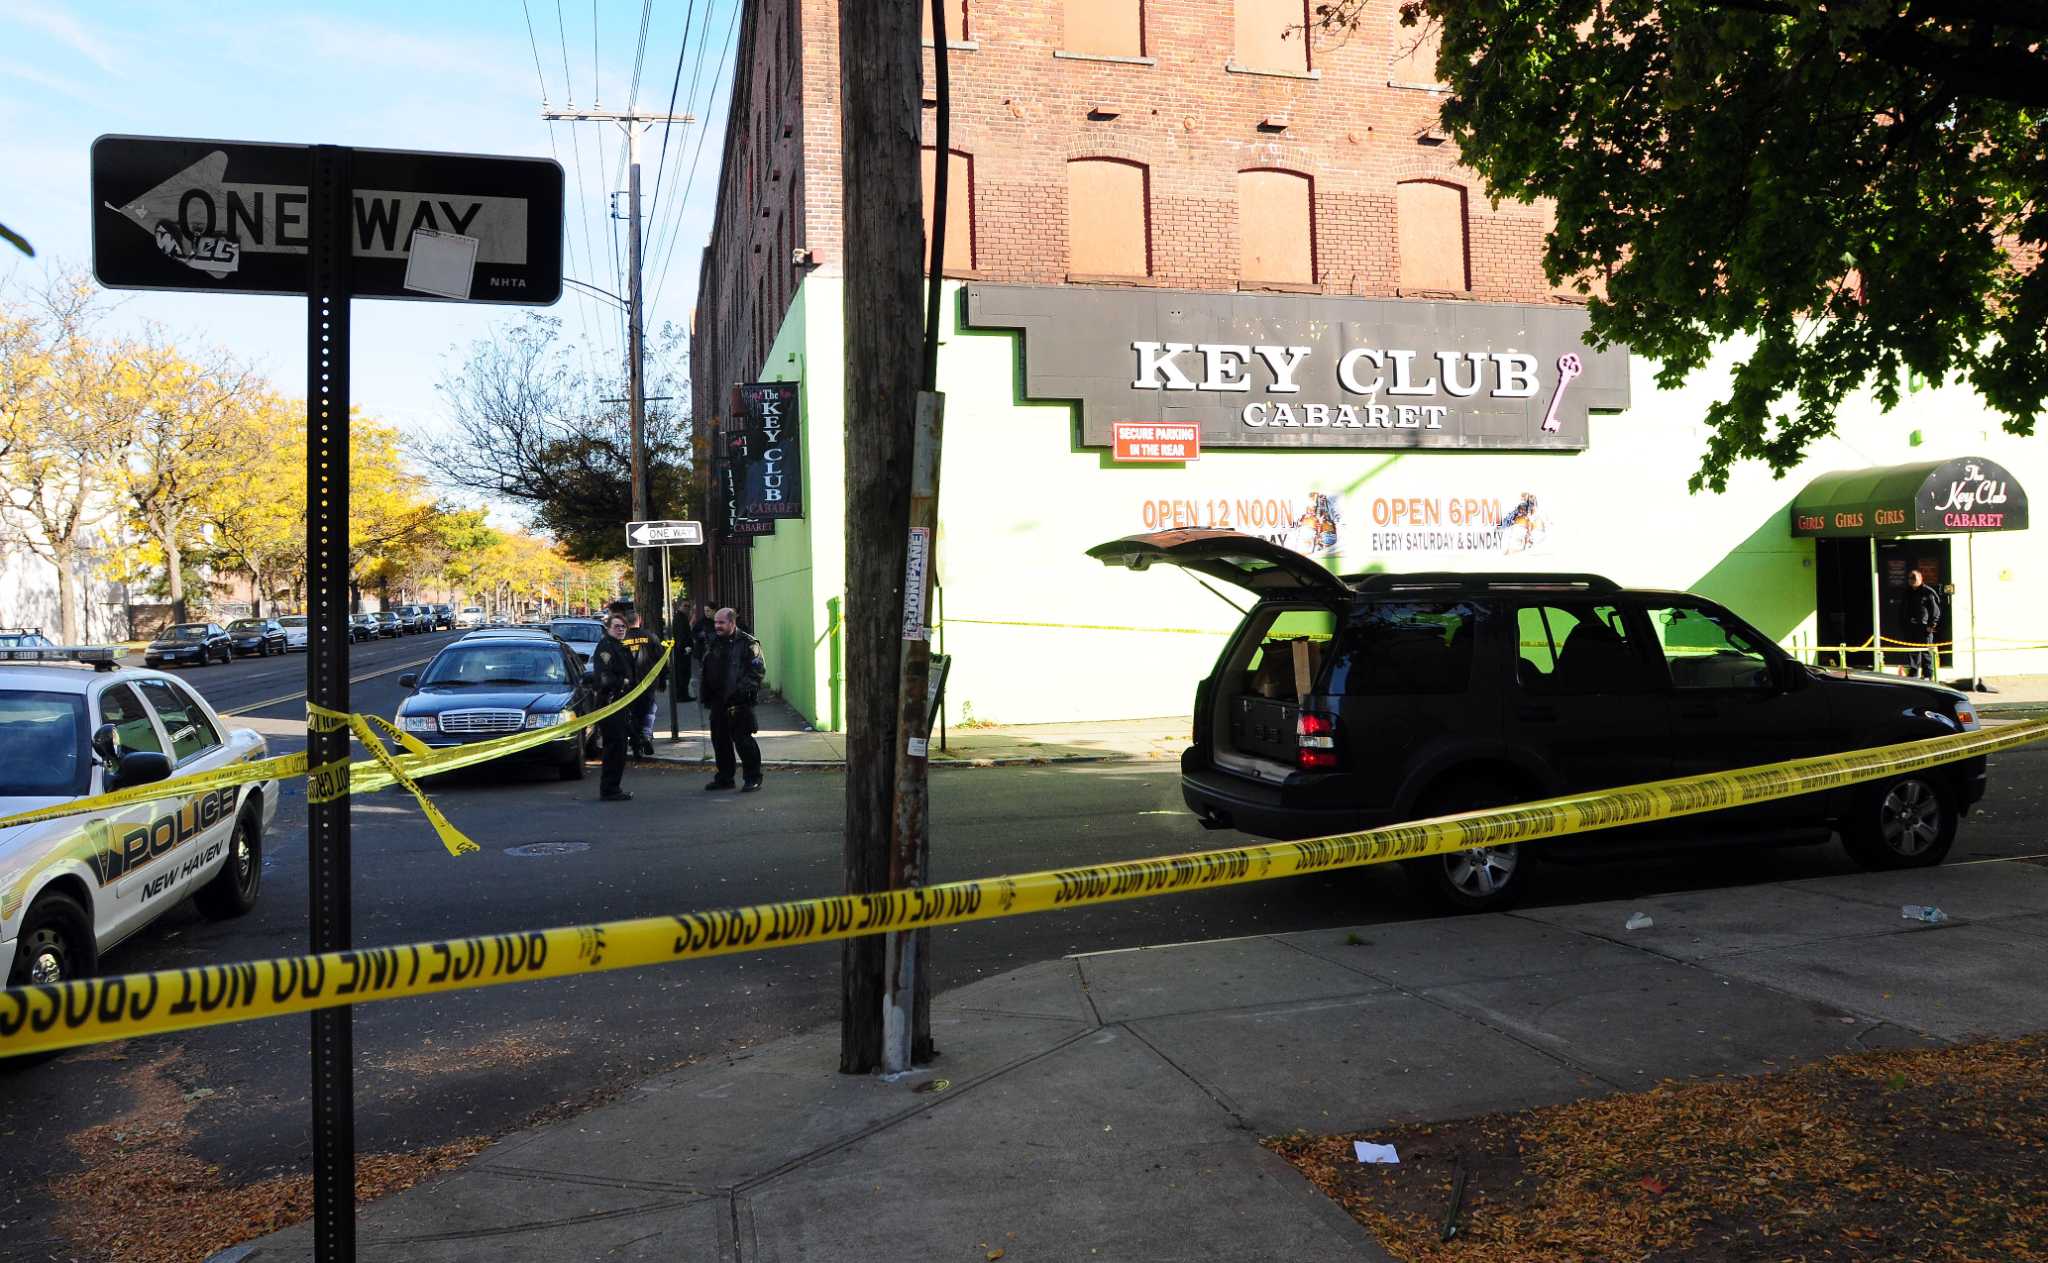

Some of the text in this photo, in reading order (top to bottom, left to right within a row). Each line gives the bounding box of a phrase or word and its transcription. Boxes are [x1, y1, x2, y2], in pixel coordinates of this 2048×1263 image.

[178, 188, 309, 246] ONE
[354, 197, 483, 251] WAY
[489, 277, 527, 288] NHTA
[1130, 341, 1541, 398] KEY CLUB
[762, 389, 779, 401] The
[1242, 402, 1448, 430] CABARET
[1119, 427, 1195, 440] SECURE PARKING
[761, 401, 784, 501] KEY CLUB
[1129, 443, 1185, 457] IN THE REAR
[1964, 464, 1985, 481] The
[1935, 480, 2008, 511] Key Club
[1142, 498, 1294, 529] OPEN 12 NOON
[1372, 497, 1502, 527] OPEN 6PM
[1835, 512, 1864, 528] GIRLS
[1874, 509, 1905, 525] GIRLS
[1944, 513, 2004, 528] CABARET
[649, 528, 694, 539] ONE WAY
[1372, 531, 1504, 551] EVERY SATURDAY & SUNDAY
[122, 785, 240, 872] POLICE
[141, 840, 223, 902] NEW HAVEN
